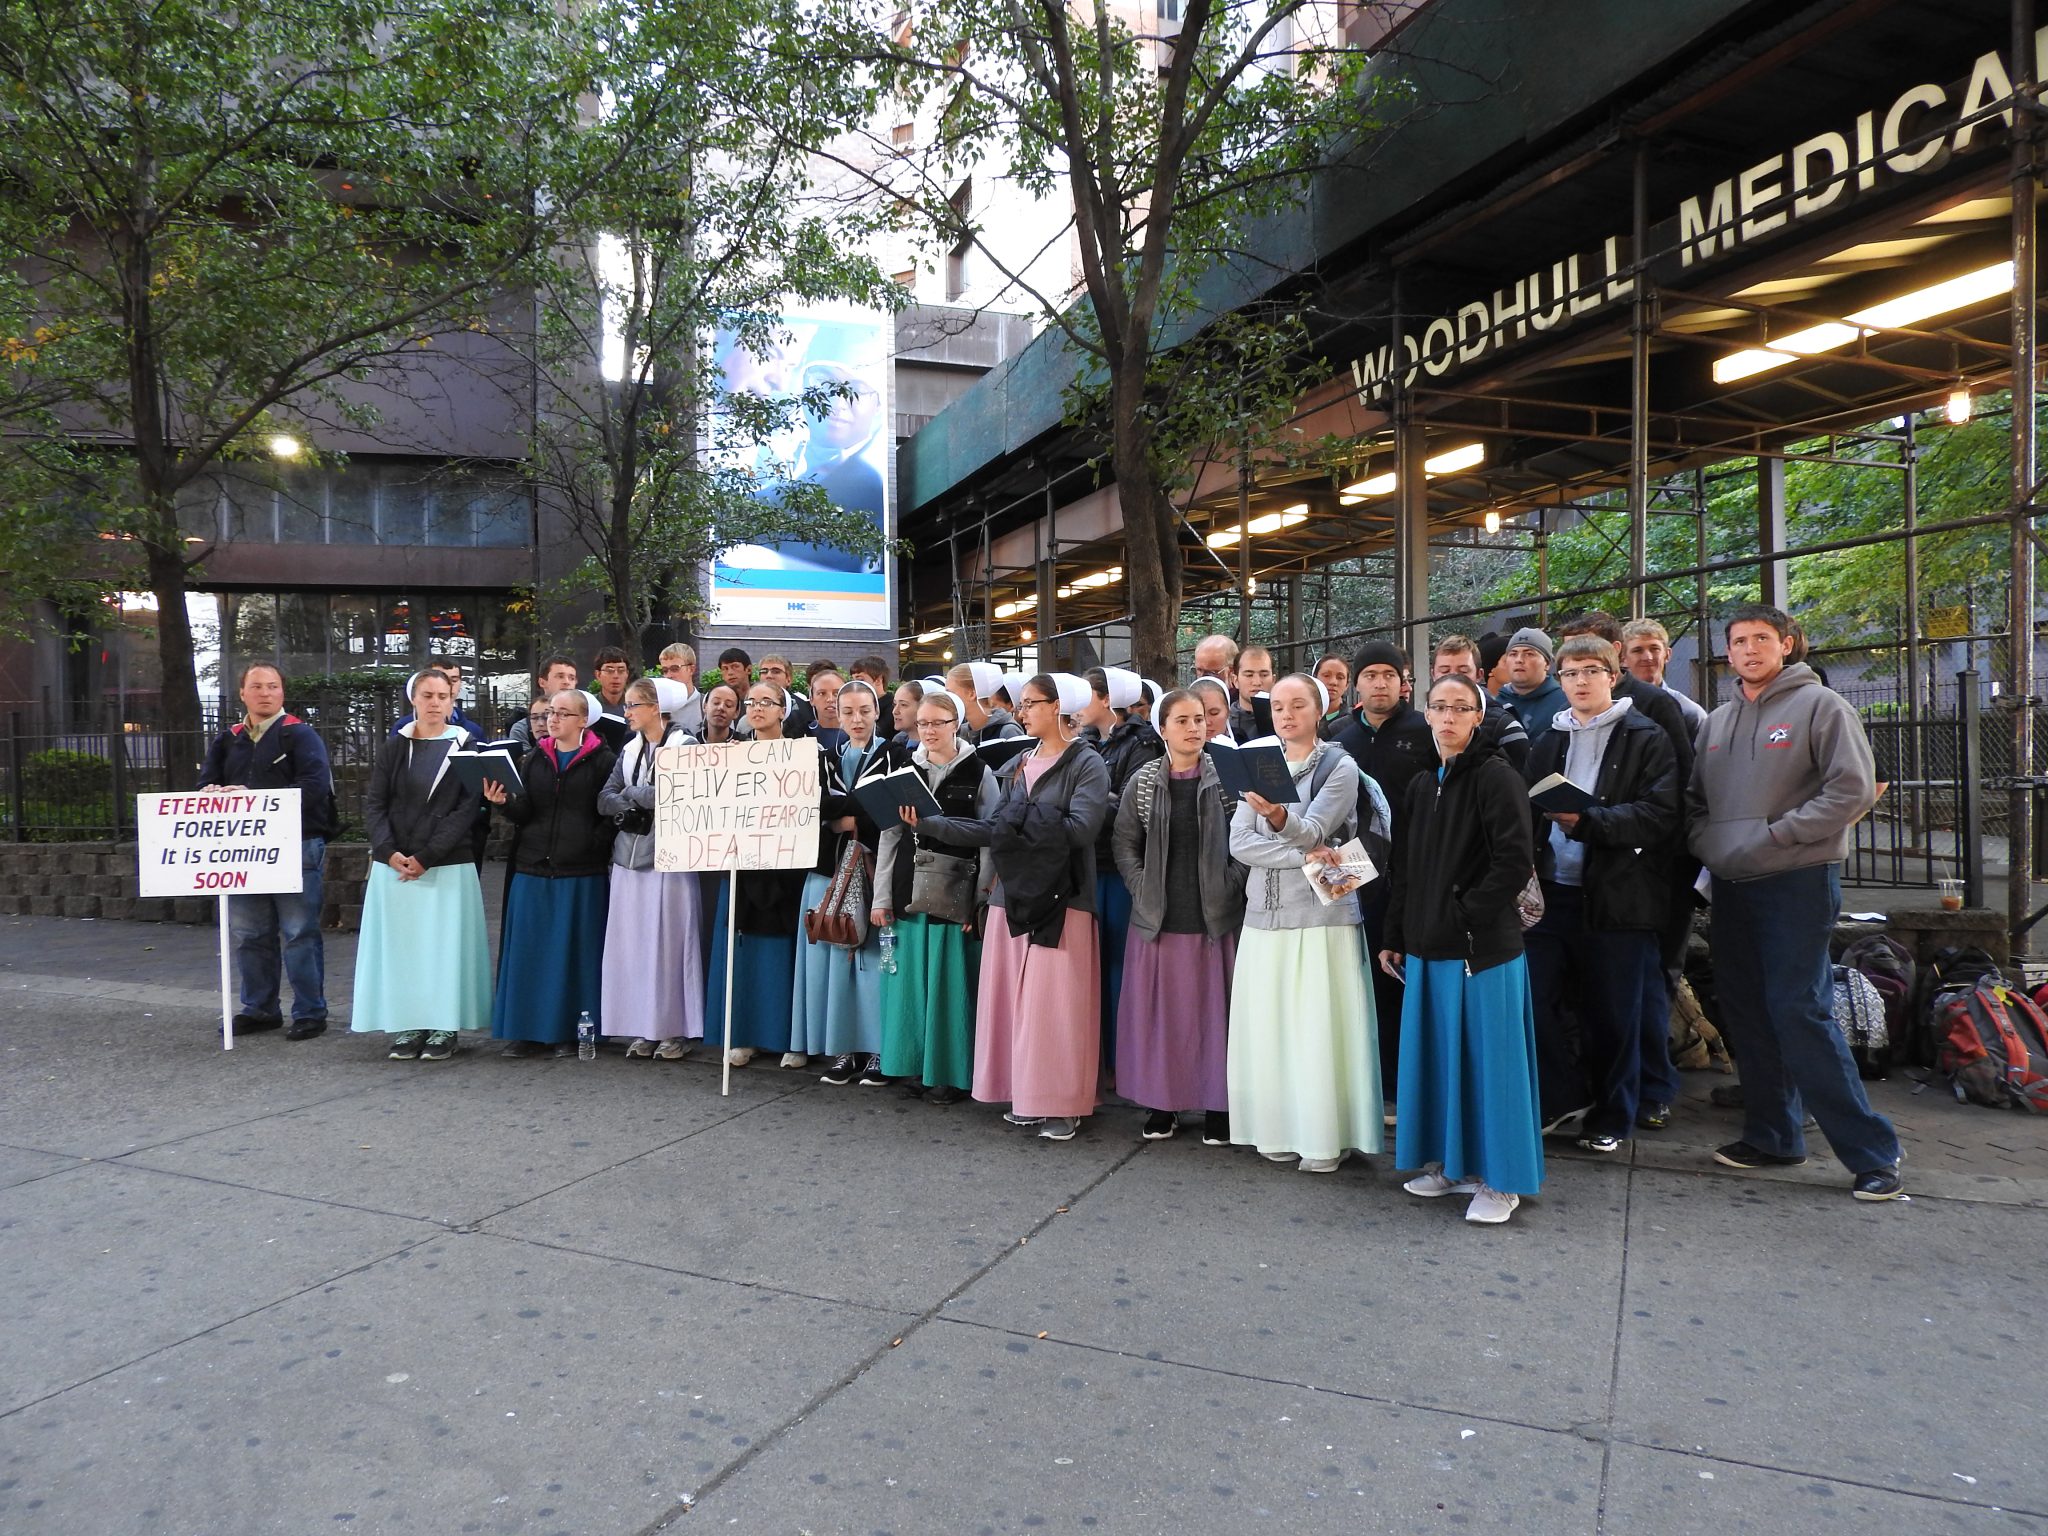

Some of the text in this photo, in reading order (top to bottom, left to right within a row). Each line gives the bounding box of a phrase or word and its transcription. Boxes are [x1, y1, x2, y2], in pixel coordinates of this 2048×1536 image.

[1351, 236, 1635, 406] WOODHULL
[787, 602, 806, 611] HHC
[656, 741, 793, 771] CHRIST CAN
[772, 769, 816, 799] YOU
[158, 795, 280, 815] ETERNITY is
[173, 819, 267, 838] FOREVER
[659, 804, 820, 838] FROM THE FEAR OF
[161, 845, 280, 865] It is coming
[688, 834, 797, 870] DEATH
[193, 871, 248, 889] SOON
